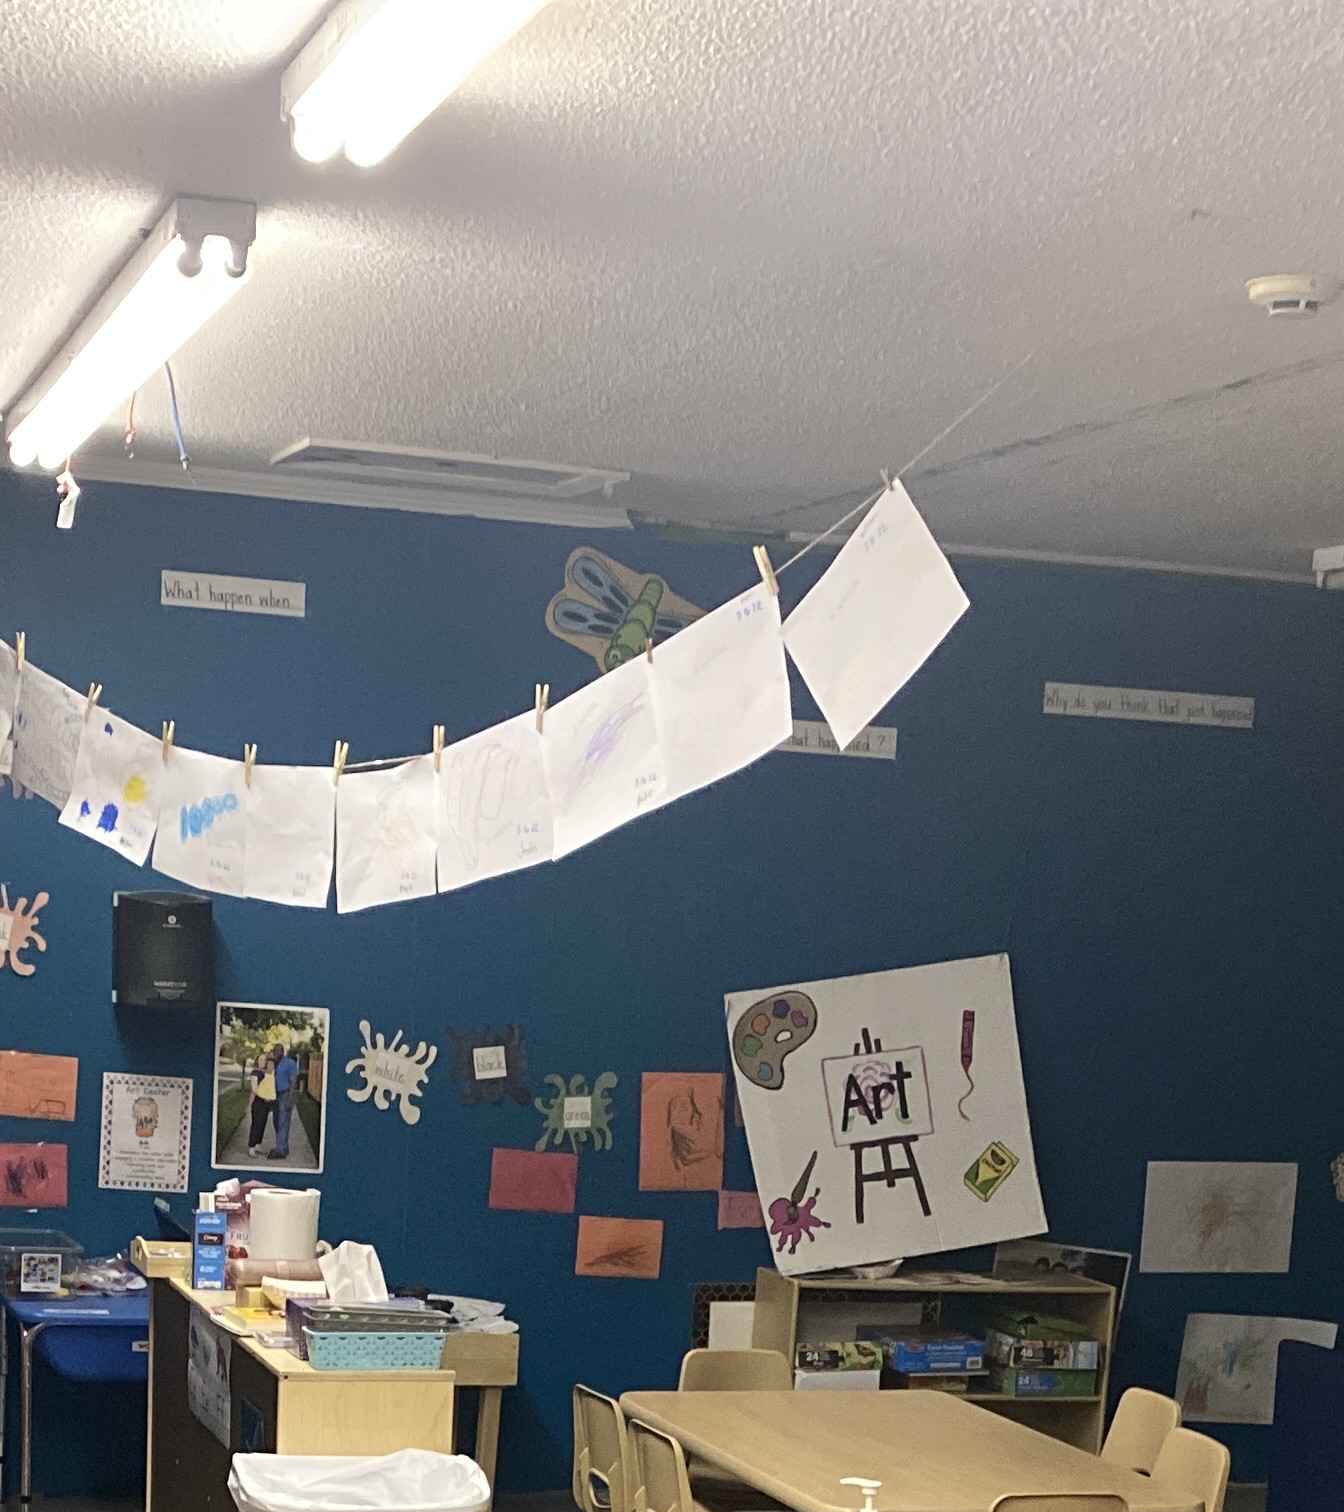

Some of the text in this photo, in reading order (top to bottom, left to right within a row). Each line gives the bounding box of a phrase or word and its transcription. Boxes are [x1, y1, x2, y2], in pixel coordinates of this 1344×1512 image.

[164, 579, 200, 600] What
[208, 582, 253, 610] happen
[476, 1053, 505, 1073] black
[841, 1060, 913, 1132] Art
